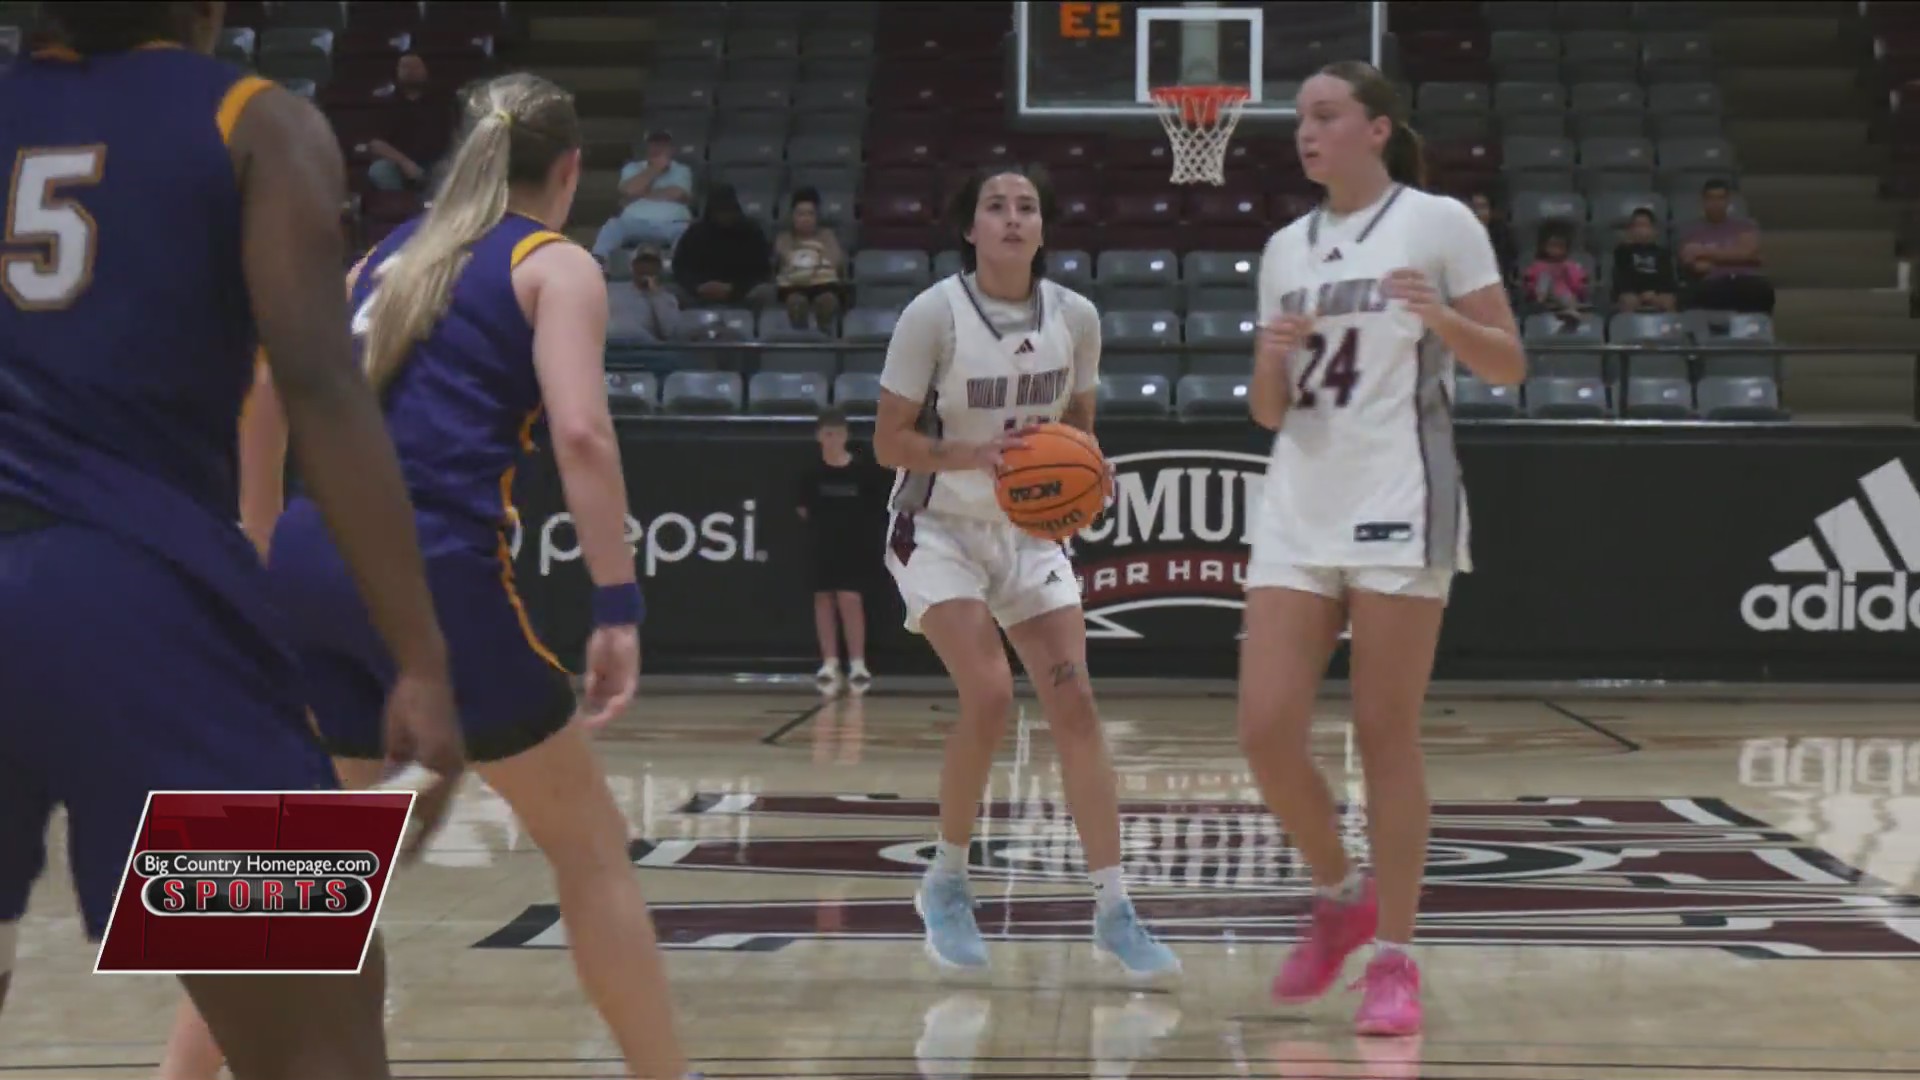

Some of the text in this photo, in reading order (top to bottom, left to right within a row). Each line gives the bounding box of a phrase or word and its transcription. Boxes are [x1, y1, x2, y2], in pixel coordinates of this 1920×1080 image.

[2, 144, 106, 311] 5
[1297, 327, 1361, 407] 24
[1094, 563, 1149, 591] AR
[1740, 570, 1920, 631] adid
